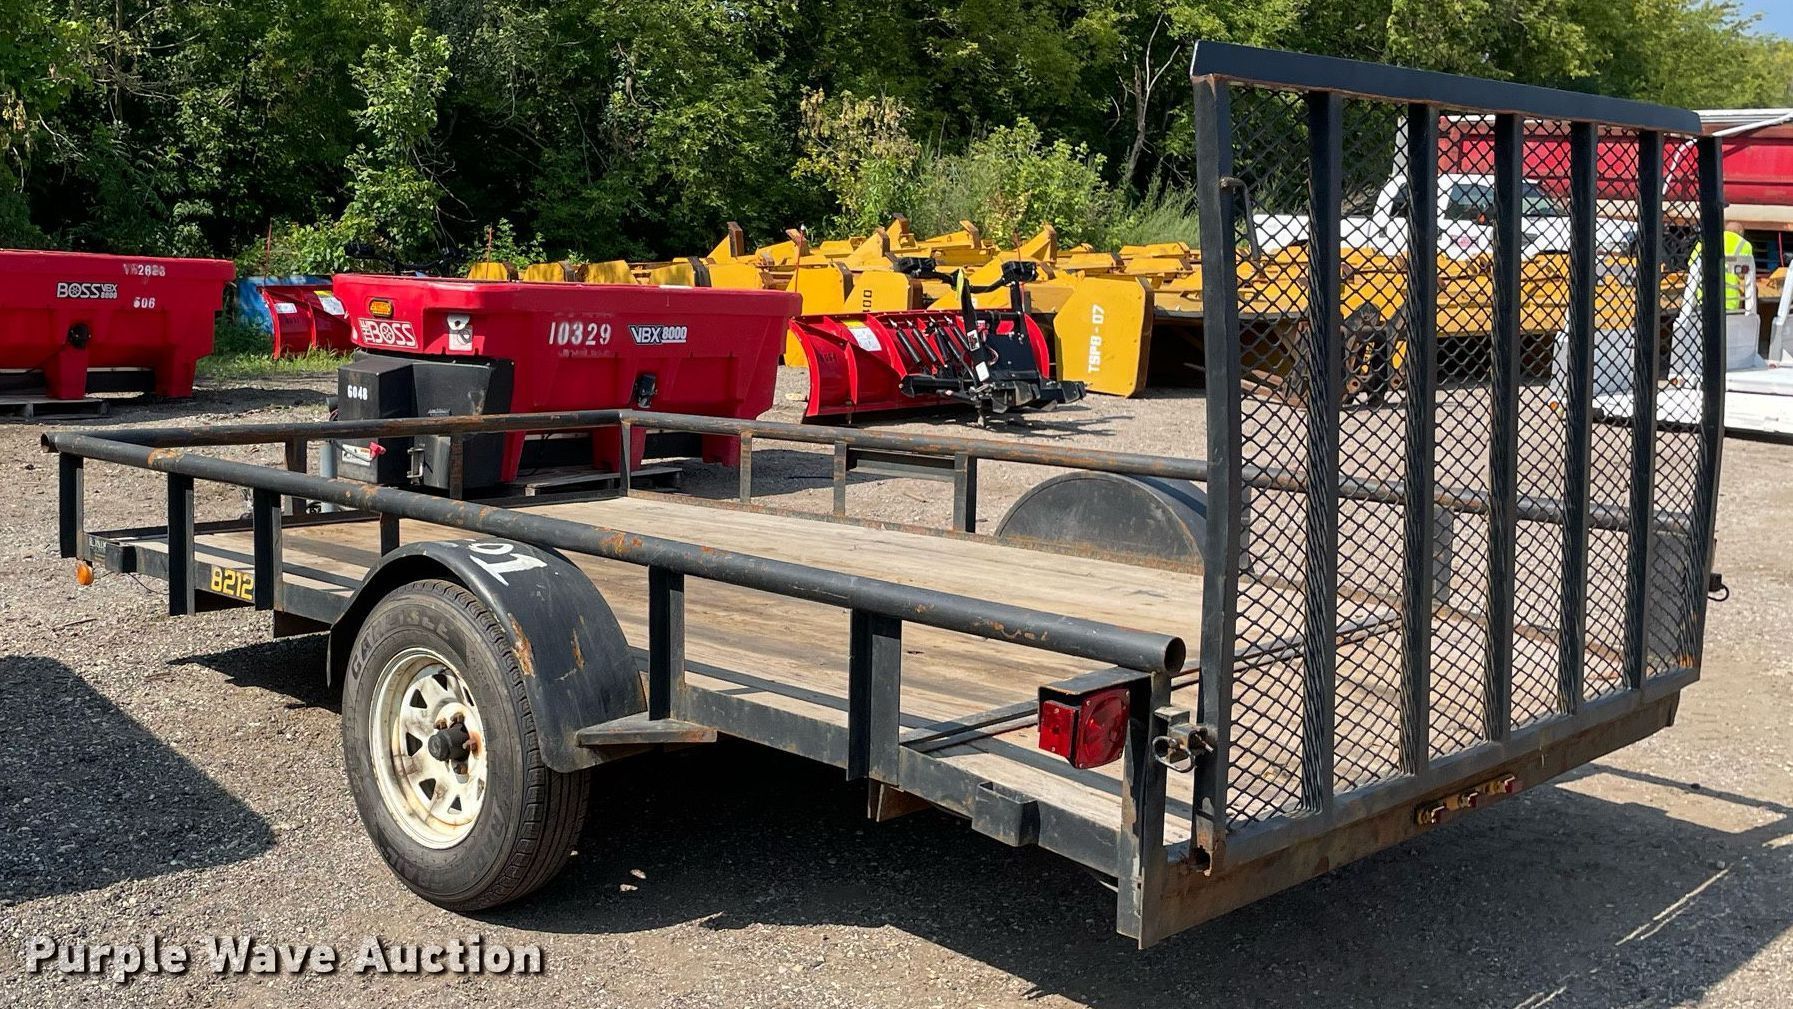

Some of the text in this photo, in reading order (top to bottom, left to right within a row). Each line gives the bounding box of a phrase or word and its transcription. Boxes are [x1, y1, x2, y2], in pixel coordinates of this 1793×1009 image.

[57, 283, 100, 298] BOSS
[368, 320, 416, 347] BOSS
[548, 321, 612, 345] 10329
[630, 326, 687, 343] VBX 8000
[210, 566, 253, 601] 8212
